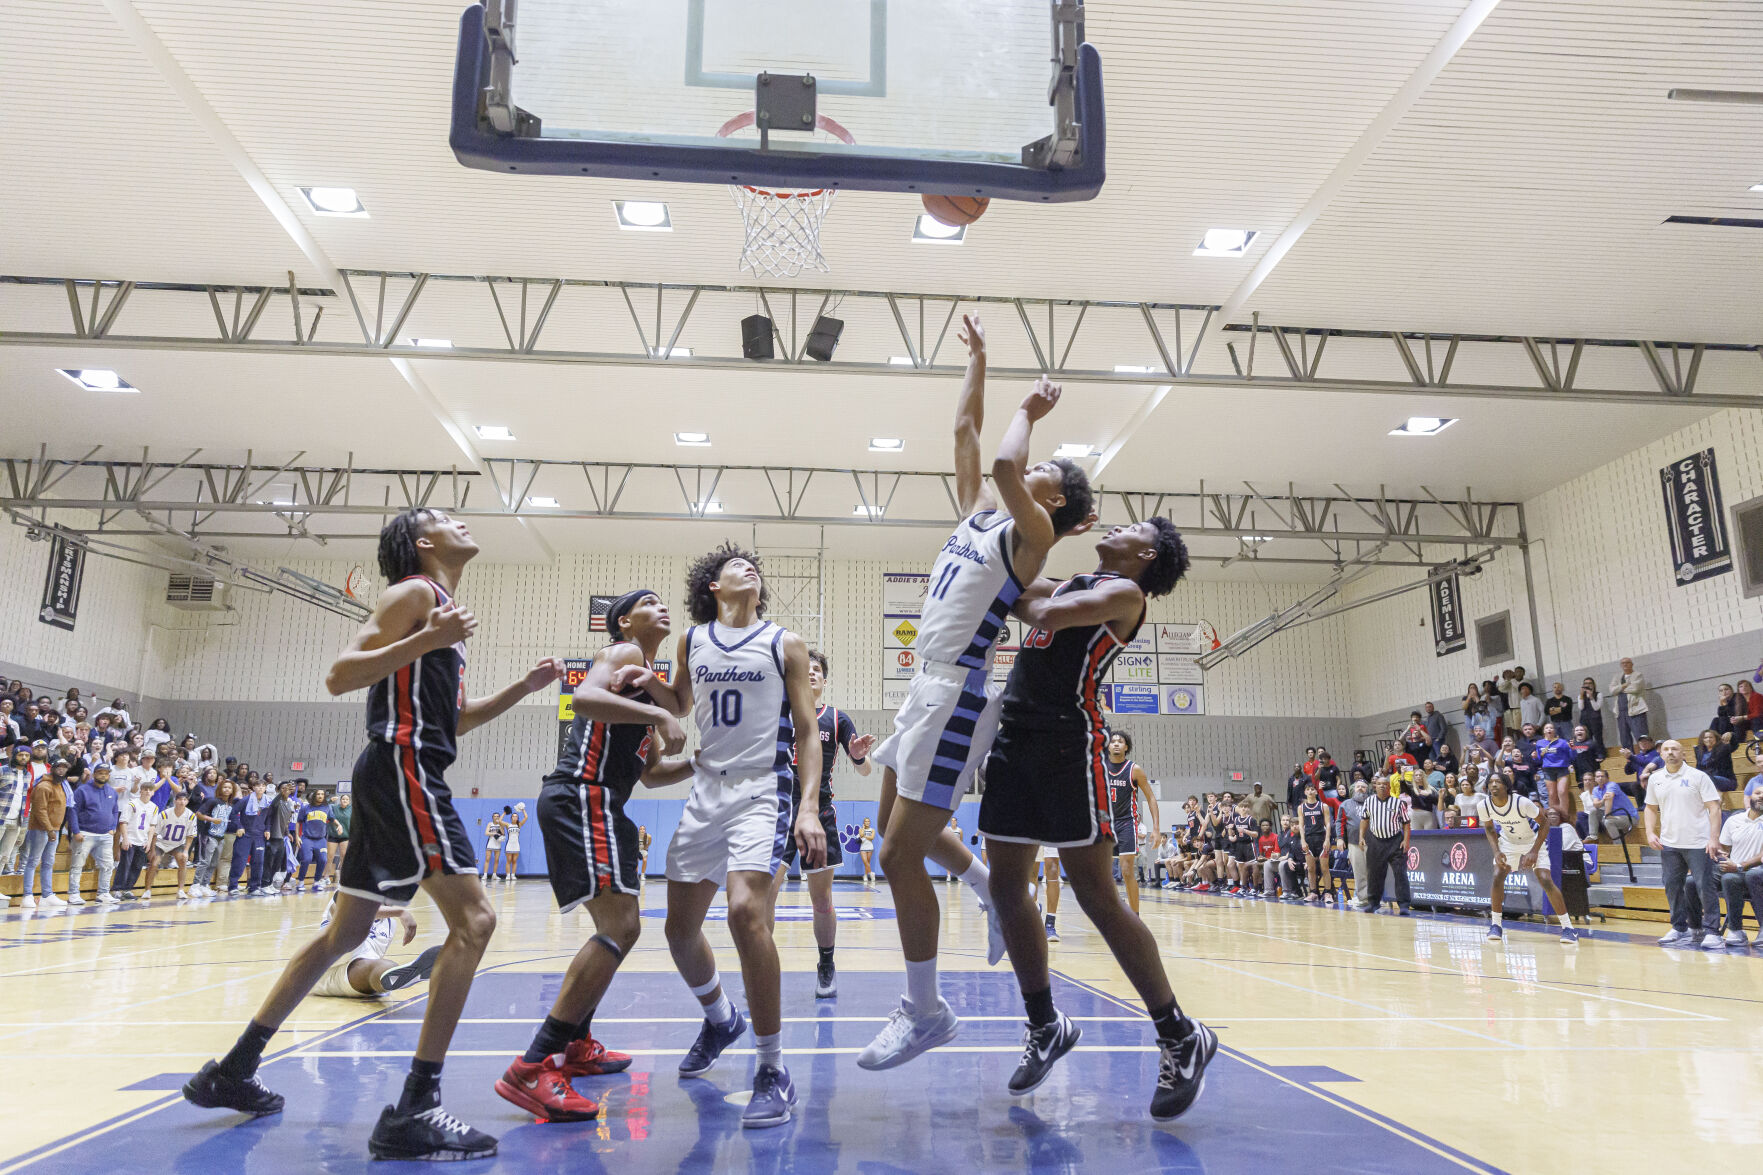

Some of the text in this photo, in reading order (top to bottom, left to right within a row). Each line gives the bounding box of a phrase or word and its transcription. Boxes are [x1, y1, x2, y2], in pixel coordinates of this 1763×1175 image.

[1679, 459, 1709, 559] CHARACTER
[941, 535, 987, 565] Panthers
[56, 545, 75, 609] RTSMANSHIP
[931, 561, 962, 601] 11
[1440, 580, 1454, 638] ADEMICS
[567, 661, 670, 671] HOME ITOR
[899, 653, 912, 665] 84
[1117, 656, 1142, 666] SIGN
[695, 664, 766, 685] Panthers
[1128, 667, 1153, 678] LITE
[709, 688, 744, 728] 10
[138, 812, 147, 831] 1
[1506, 825, 1516, 834] 2
[163, 823, 186, 842] 10
[1441, 871, 1476, 886] ARENA
